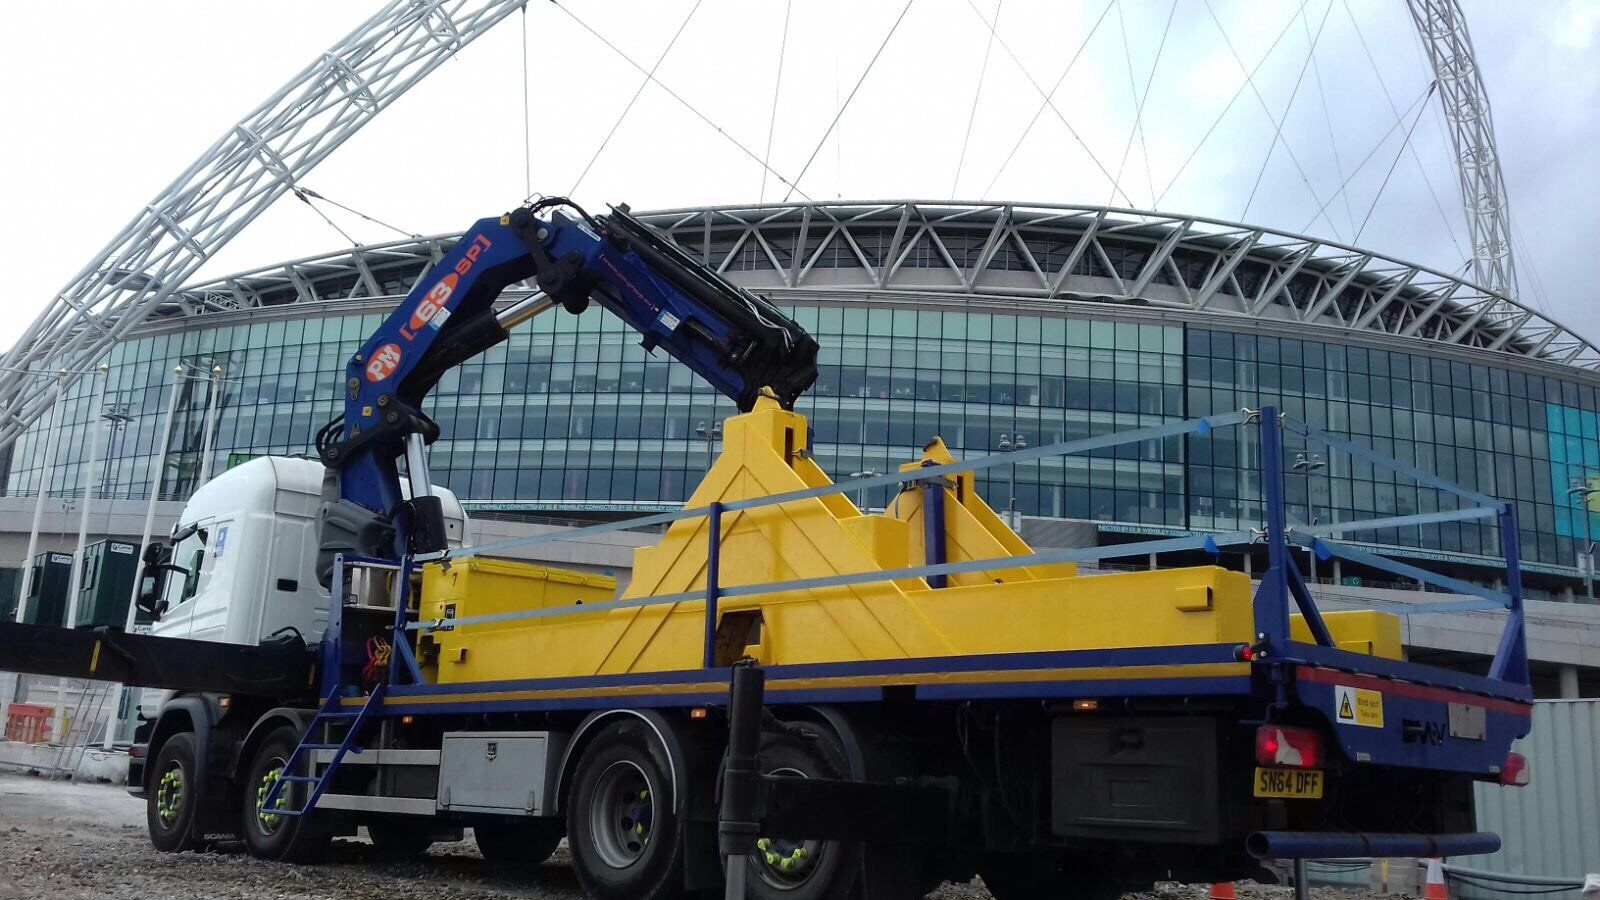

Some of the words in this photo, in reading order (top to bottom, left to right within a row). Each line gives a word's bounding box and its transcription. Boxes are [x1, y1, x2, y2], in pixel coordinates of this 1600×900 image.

[366, 344, 401, 382] PM
[481, 503, 506, 511] WEMBLEY
[559, 503, 585, 511] WEMBLEY
[585, 503, 618, 511] CONNECTED
[1142, 527, 1170, 536] WEMBLEY
[1260, 770, 1293, 792] SN64
[1296, 772, 1319, 793] DFF
